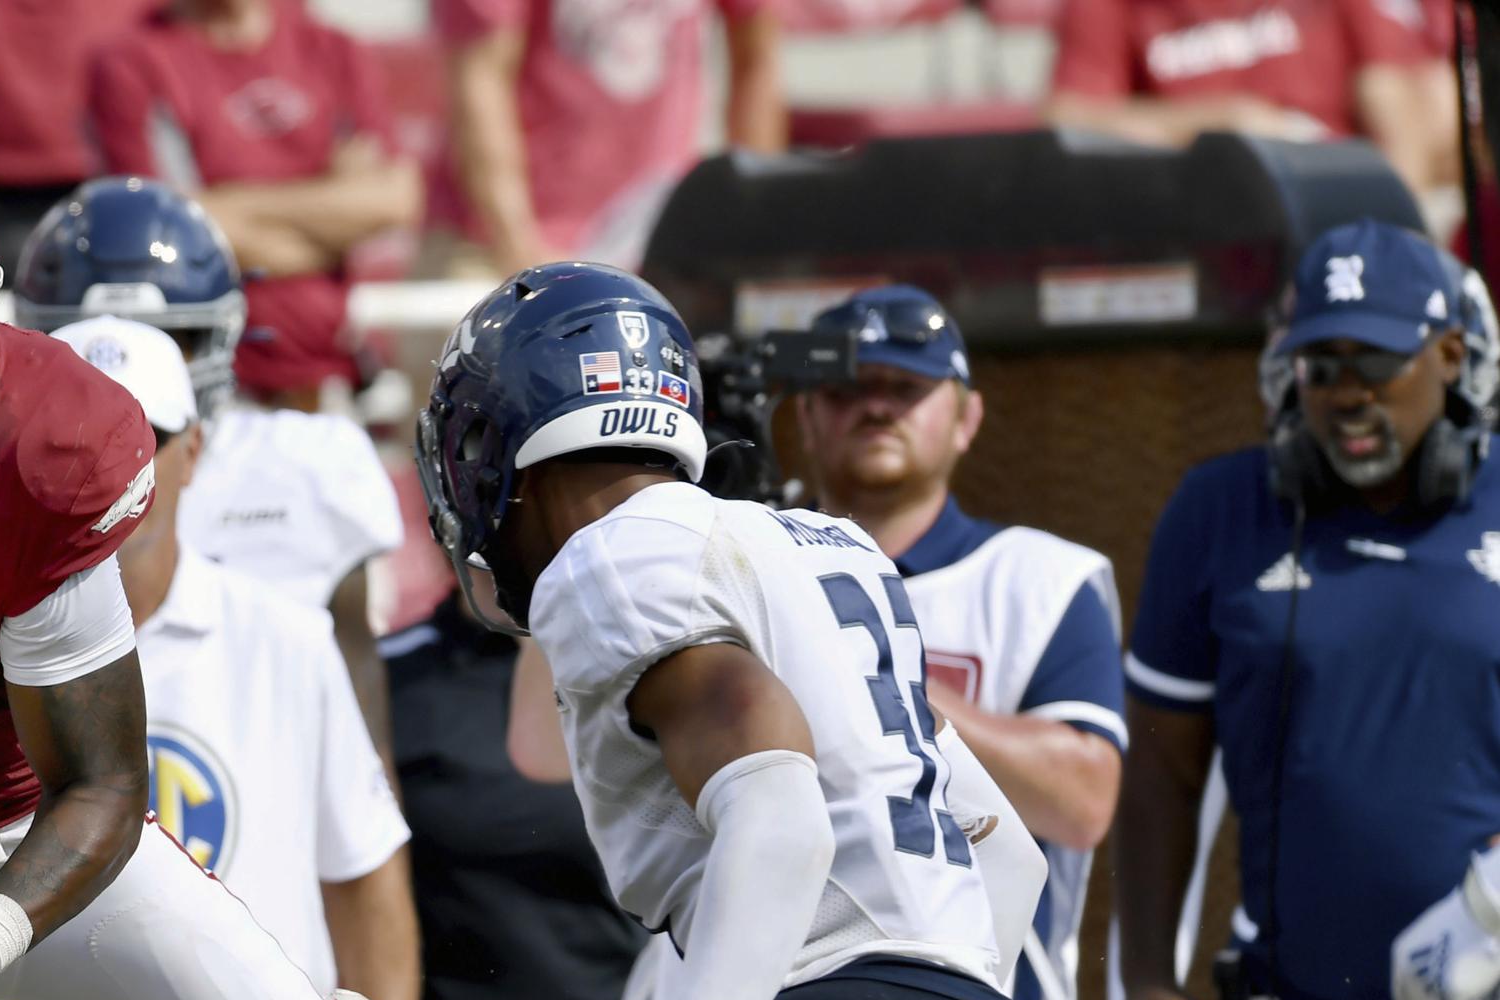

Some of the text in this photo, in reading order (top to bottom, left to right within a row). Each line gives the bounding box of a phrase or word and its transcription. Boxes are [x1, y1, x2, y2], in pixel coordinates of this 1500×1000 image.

[625, 368, 655, 395] 33
[600, 407, 678, 438] OWLS
[816, 571, 972, 869] 33
